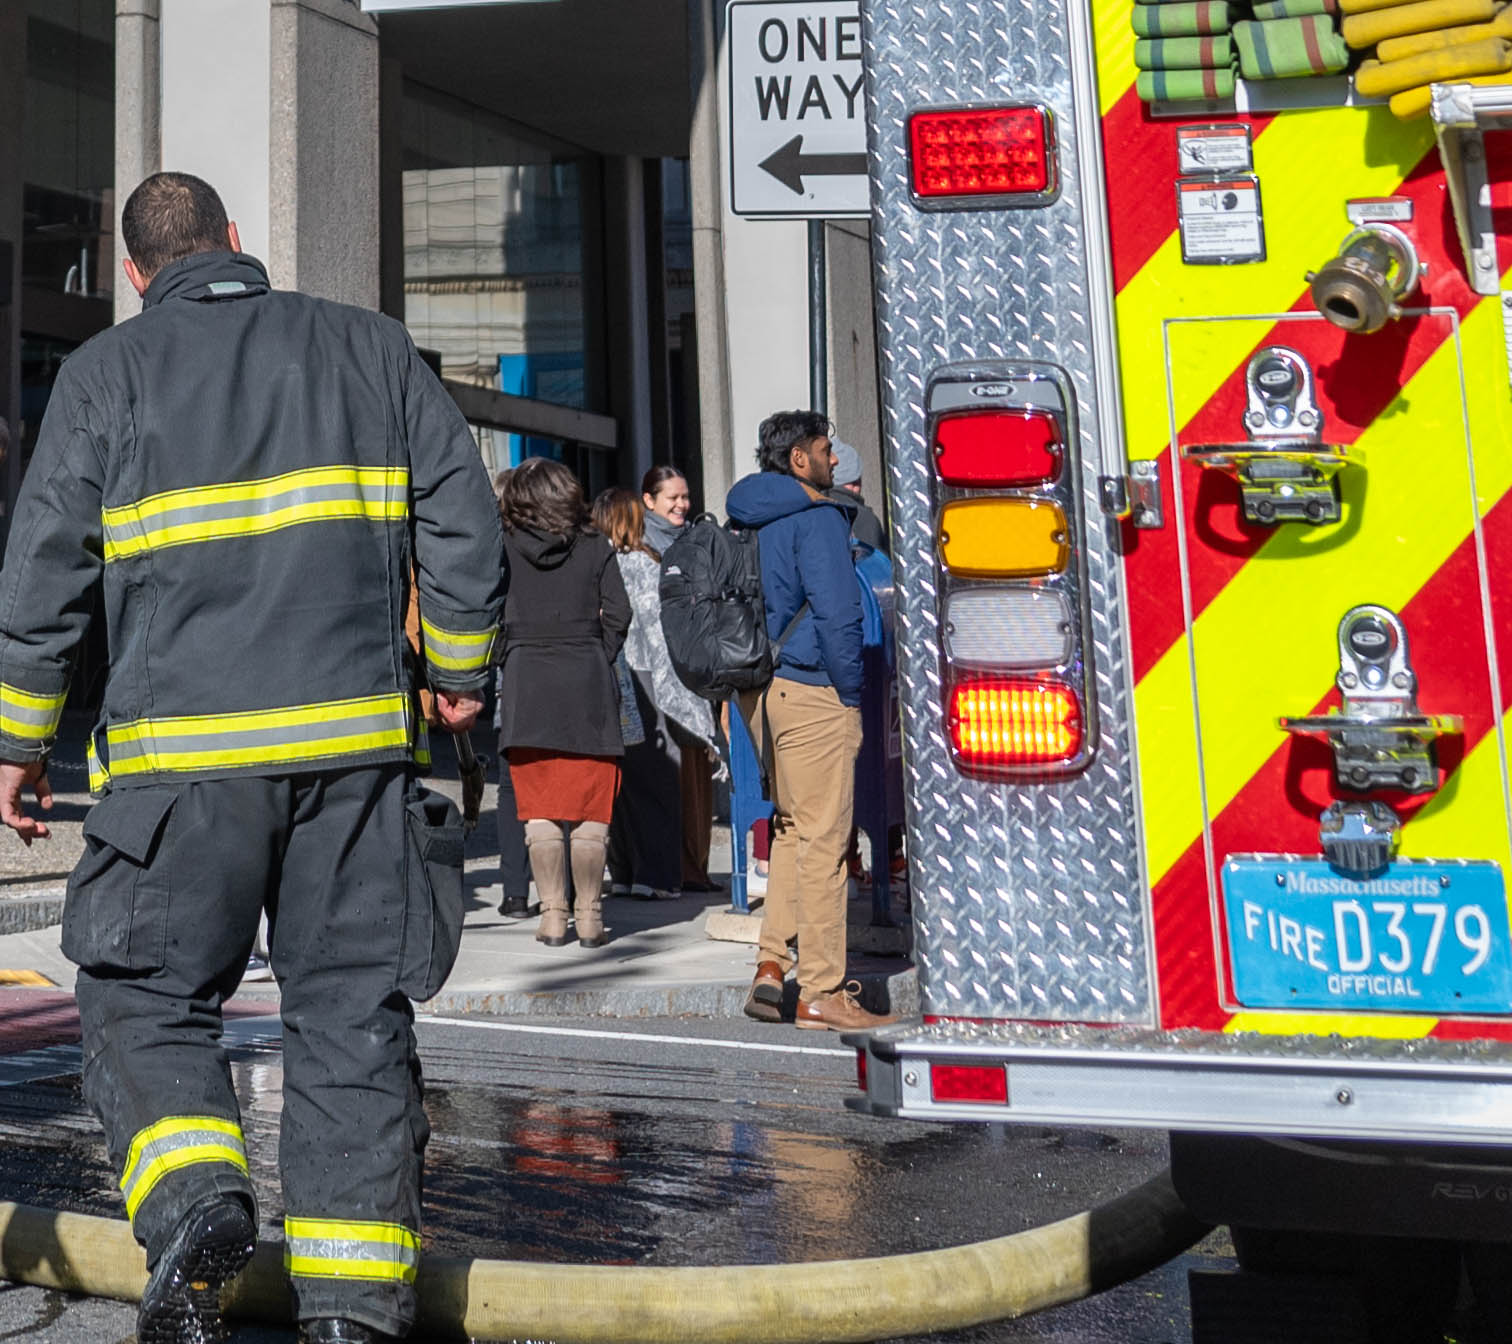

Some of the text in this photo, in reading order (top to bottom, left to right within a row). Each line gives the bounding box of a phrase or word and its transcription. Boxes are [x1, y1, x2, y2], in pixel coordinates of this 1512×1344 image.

[758, 16, 863, 64] ONE
[754, 73, 866, 121] WAY
[1285, 870, 1441, 897] Massachusetts
[1242, 899, 1492, 976] FIRE D379
[1327, 974, 1421, 998] OFFICIAL
